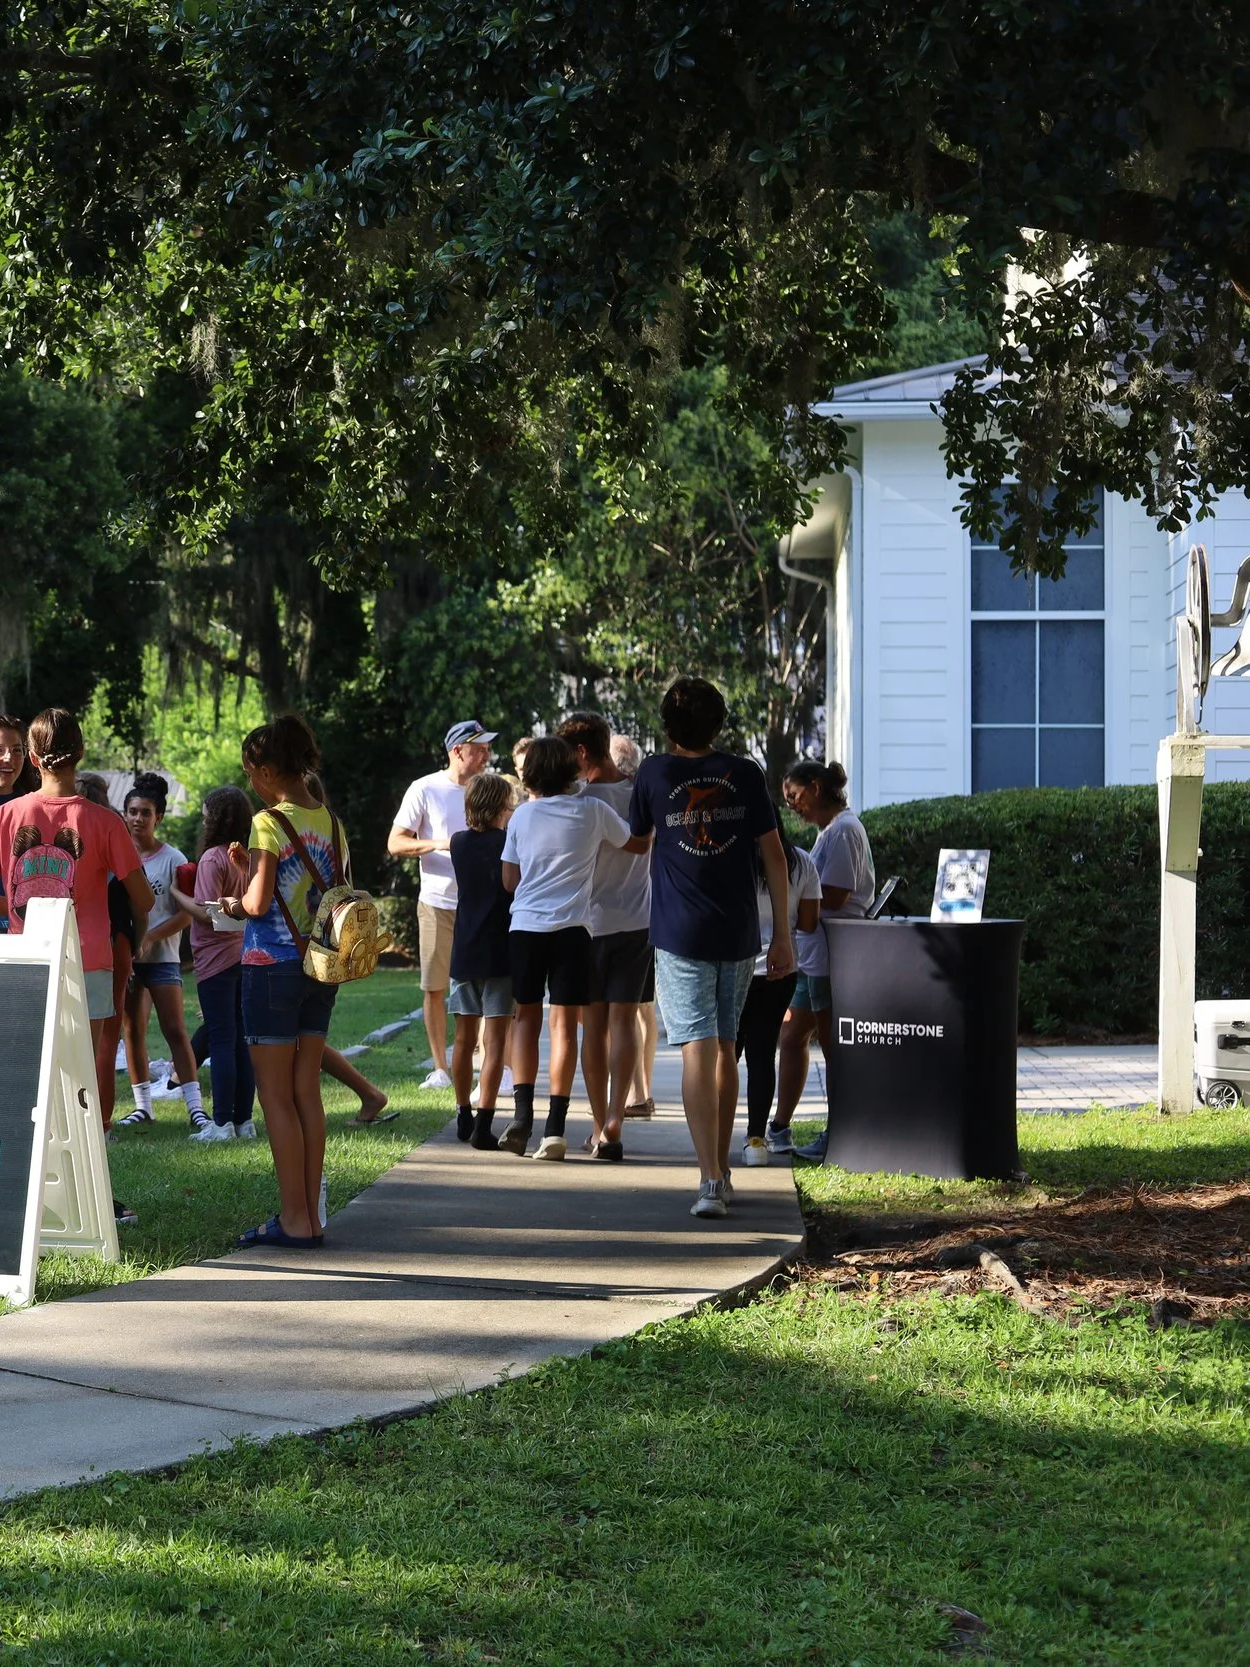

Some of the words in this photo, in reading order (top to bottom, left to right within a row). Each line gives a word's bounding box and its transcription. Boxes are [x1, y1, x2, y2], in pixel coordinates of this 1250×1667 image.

[22, 855, 70, 880] MINI
[856, 1020, 944, 1038] CORNERSTONE
[857, 1034, 901, 1046] CHURCH
